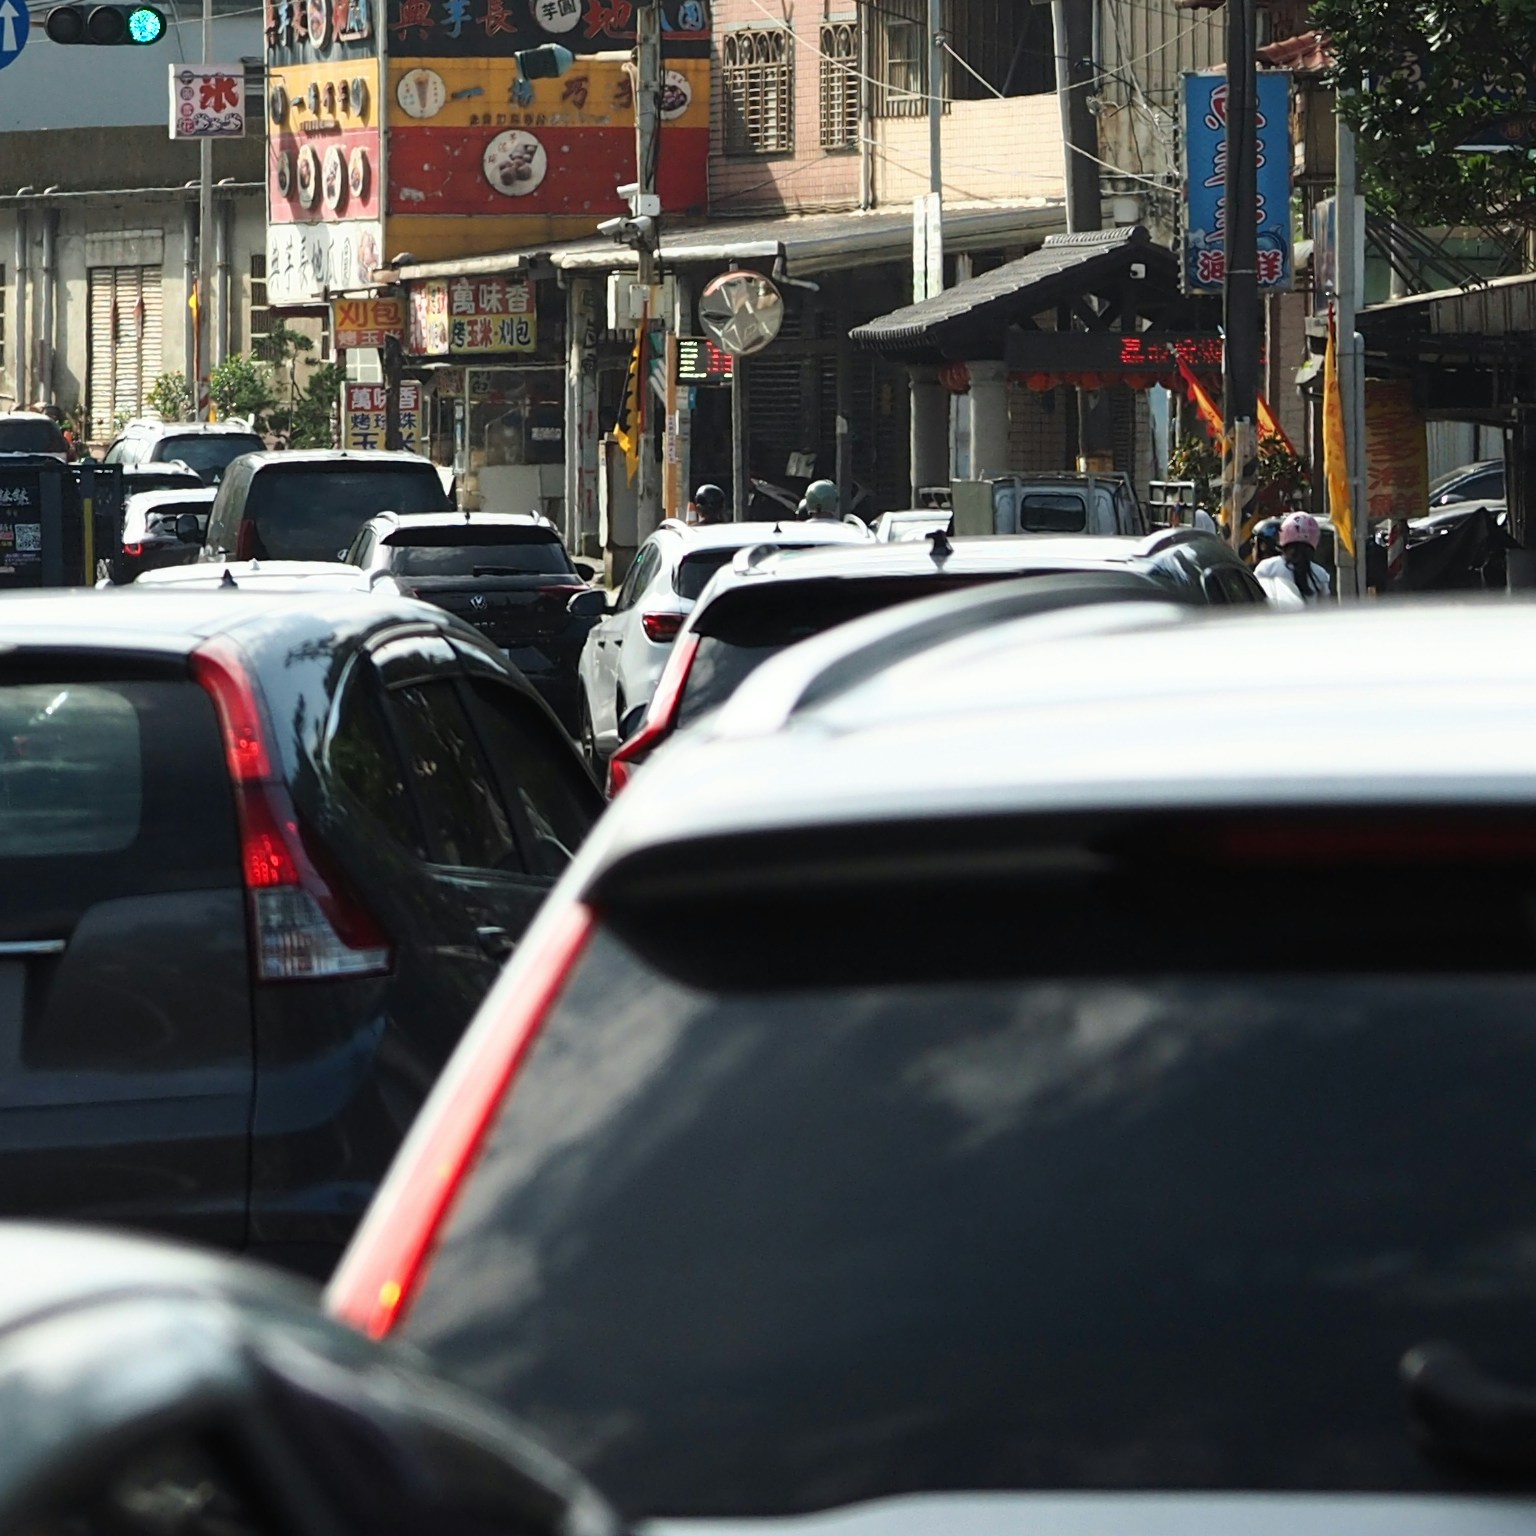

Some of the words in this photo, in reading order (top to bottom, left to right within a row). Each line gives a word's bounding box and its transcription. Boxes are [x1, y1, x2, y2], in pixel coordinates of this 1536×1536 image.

[451, 283, 530, 315] 萬味香
[337, 301, 402, 327] 刈包
